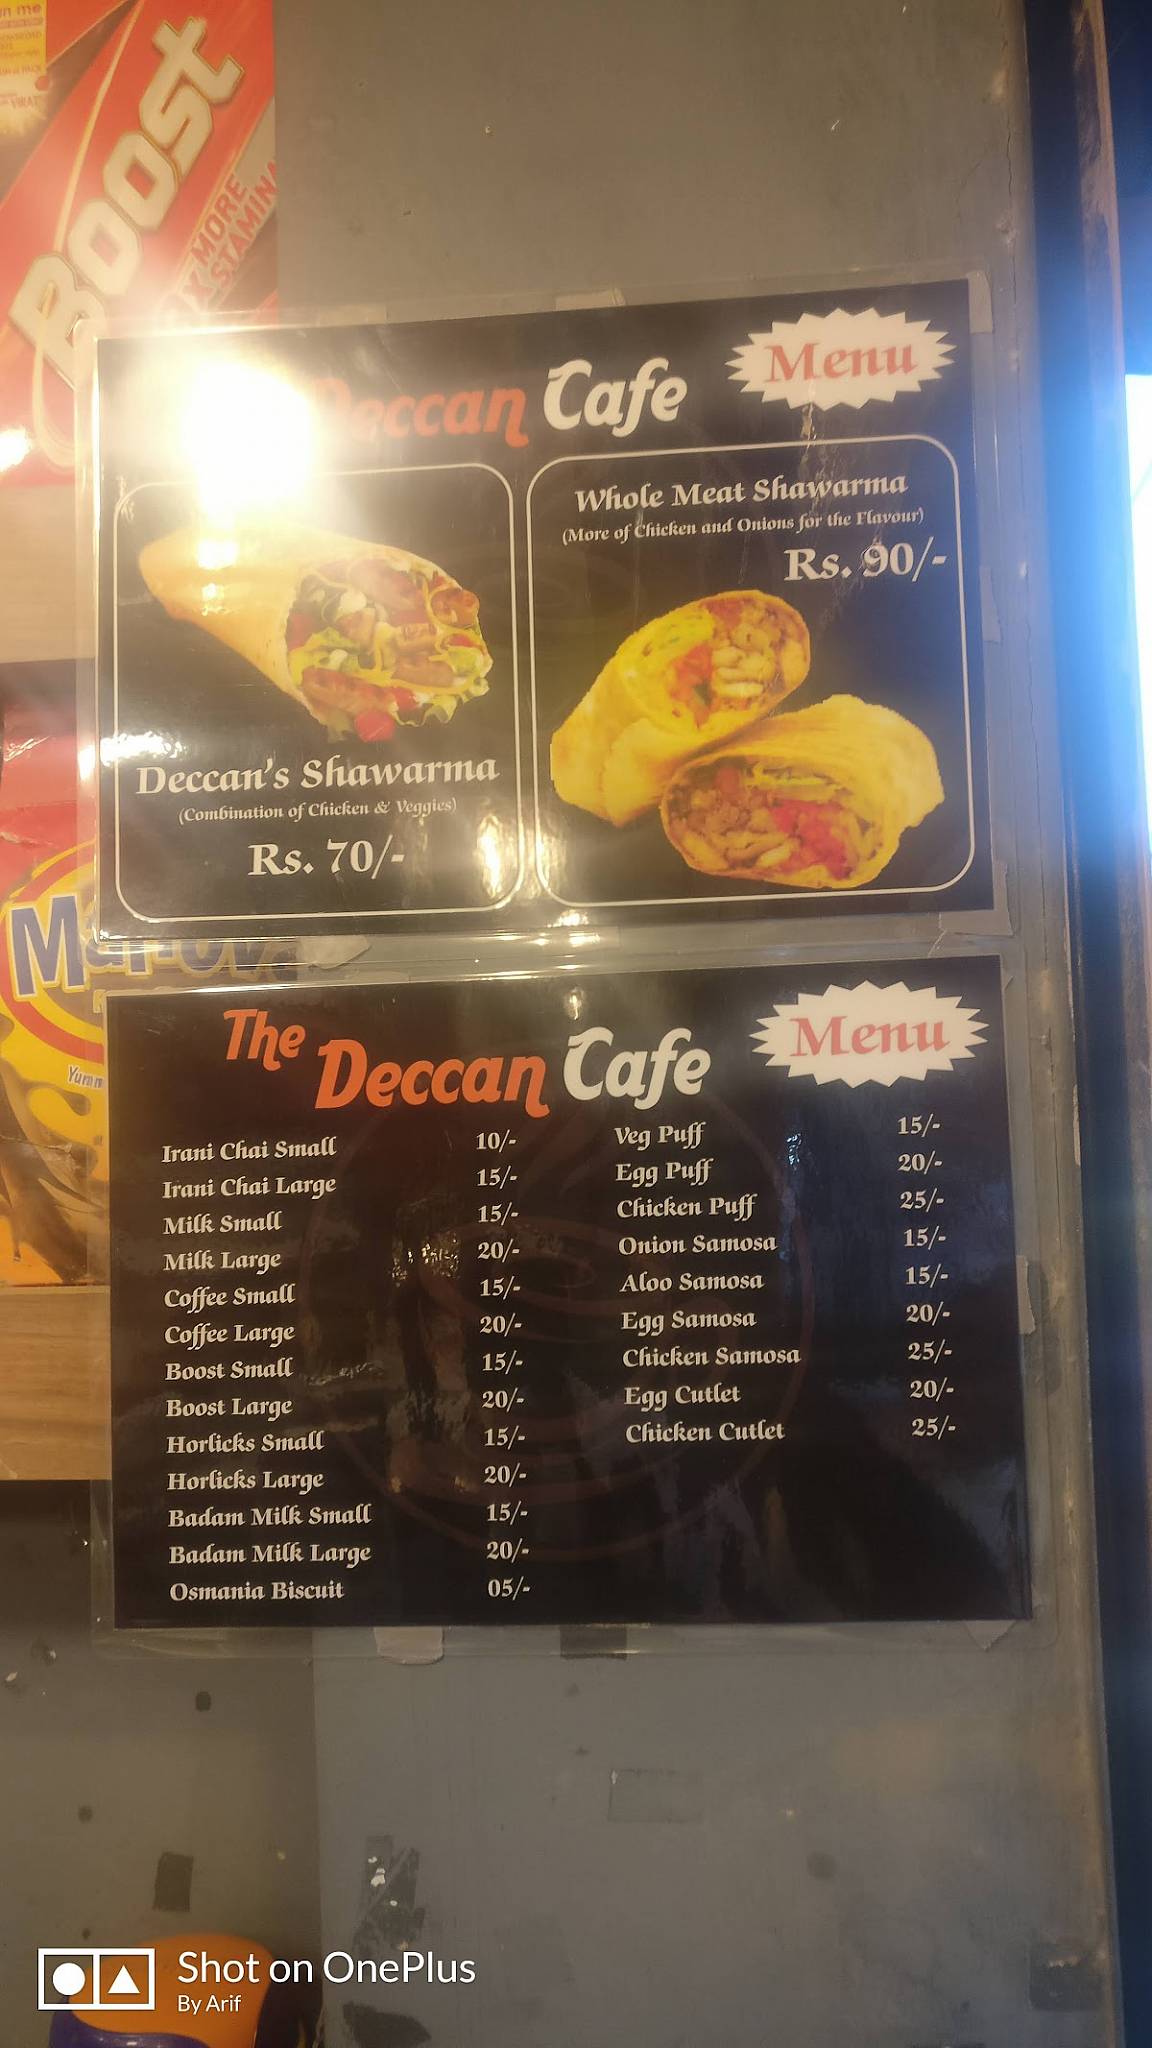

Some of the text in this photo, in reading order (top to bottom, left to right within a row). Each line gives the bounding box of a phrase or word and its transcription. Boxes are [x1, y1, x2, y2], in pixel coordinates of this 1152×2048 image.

[8, 16, 246, 391] Boost
[190, 173, 248, 268] MORE
[764, 341, 918, 384] Menu
[542, 356, 687, 439] Cafe
[575, 473, 908, 512] Whole Meat Shawarma
[562, 507, 924, 546] (More of Chicken and Onions for the Flavour)
[784, 536, 947, 582] Rs. 90/-
[136, 754, 500, 795] Deccan's Shawarma
[178, 798, 457, 825] (Combination of Chicken & Veggies)
[248, 834, 404, 880] Rs. 70/-
[790, 1011, 951, 1059] Menu
[224, 1009, 712, 1118] The Deccan Cafe
[614, 1121, 706, 1150] Veg Puff
[898, 1114, 940, 1137] 15/-
[162, 1137, 336, 1163] Irani Chai Small
[476, 1130, 517, 1152] 10/-
[615, 1158, 714, 1187] Egg Puff
[898, 1150, 943, 1174] 20/-
[162, 1176, 336, 1200] Irani Chai Large
[476, 1168, 518, 1189] 15/-
[617, 1194, 758, 1221] Chicken Puff
[900, 1188, 944, 1212] 25/-
[163, 1211, 282, 1235] Milk Small
[478, 1204, 519, 1225] 15/-
[618, 1235, 778, 1255] Onion Samosa
[903, 1226, 947, 1250] 15/-
[163, 1251, 281, 1274] Milk Large
[478, 1241, 520, 1262] 20/-
[620, 1272, 765, 1292] Aloo Samosa
[905, 1264, 949, 1288] 15/-
[164, 1284, 295, 1313] Coffee Small
[479, 1278, 521, 1299] 15/-
[480, 1314, 522, 1336] 20/-
[621, 1310, 757, 1336] Egg Samosa
[906, 1302, 950, 1326] 20/-
[165, 1324, 296, 1350] Coffee Large
[481, 1352, 523, 1373] 15/-
[622, 1347, 801, 1367] Chicken Samosa
[908, 1339, 953, 1364] 25/-
[165, 1358, 293, 1380] Boost Small
[482, 1389, 524, 1411] 20/-
[624, 1384, 741, 1411] Egg Cutlet
[910, 1378, 954, 1401] 20/-
[166, 1398, 293, 1421] Boost Large
[484, 1427, 526, 1449] 15/-
[625, 1421, 785, 1443] Chicken Cutlet
[911, 1416, 956, 1440] 25/-
[167, 1431, 324, 1454] Horlicks Small
[168, 1471, 324, 1495] Horlicks Large
[484, 1464, 527, 1486] 20/-
[168, 1504, 372, 1527] Badam Milk Small
[486, 1502, 528, 1524] 15/-
[169, 1543, 371, 1568] Badam Milk Large
[486, 1540, 530, 1562] 20/-
[169, 1581, 344, 1601] Osmania Biscuit
[487, 1577, 530, 1599] 05/-
